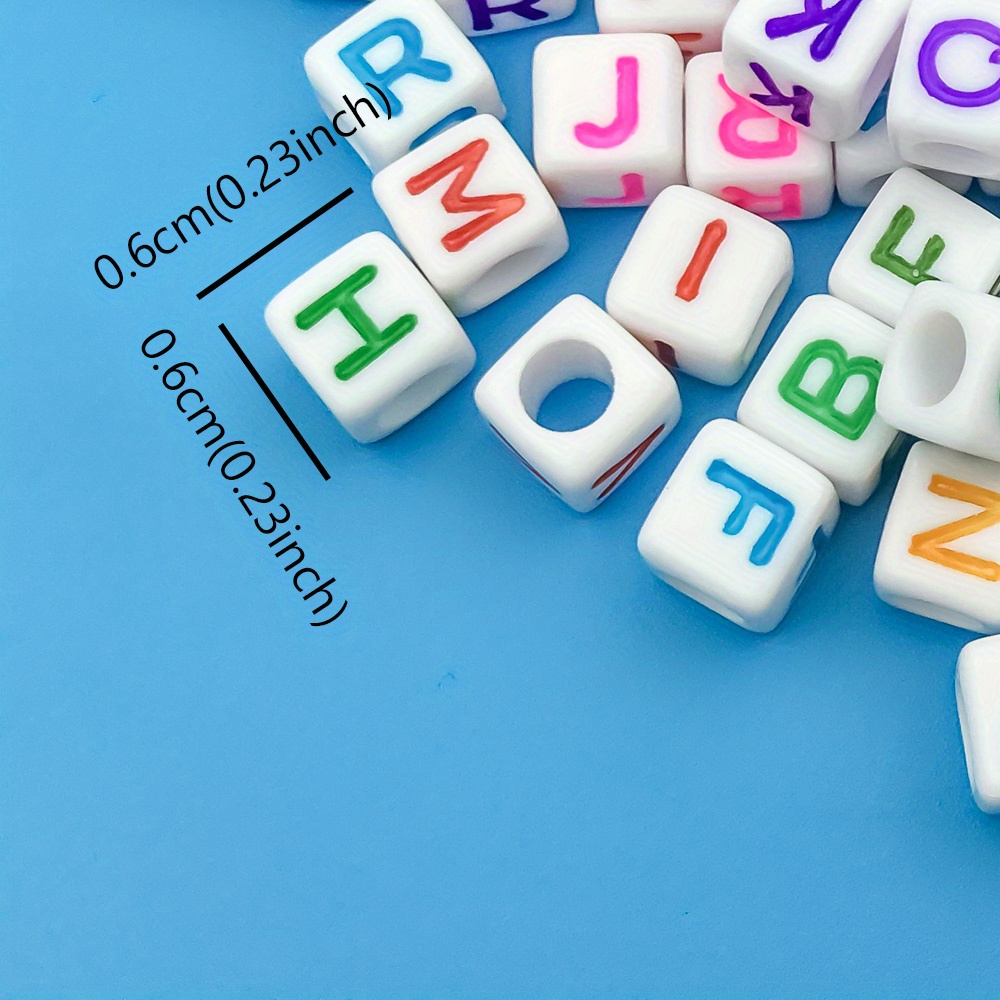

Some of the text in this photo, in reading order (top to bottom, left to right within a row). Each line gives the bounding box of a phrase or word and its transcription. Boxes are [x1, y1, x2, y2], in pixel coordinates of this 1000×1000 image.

[338, 18, 452, 117] R
[574, 56, 639, 148] J
[675, 219, 726, 302] I
[295, 265, 417, 381] H
[778, 339, 882, 440] B
[706, 459, 795, 566] F
